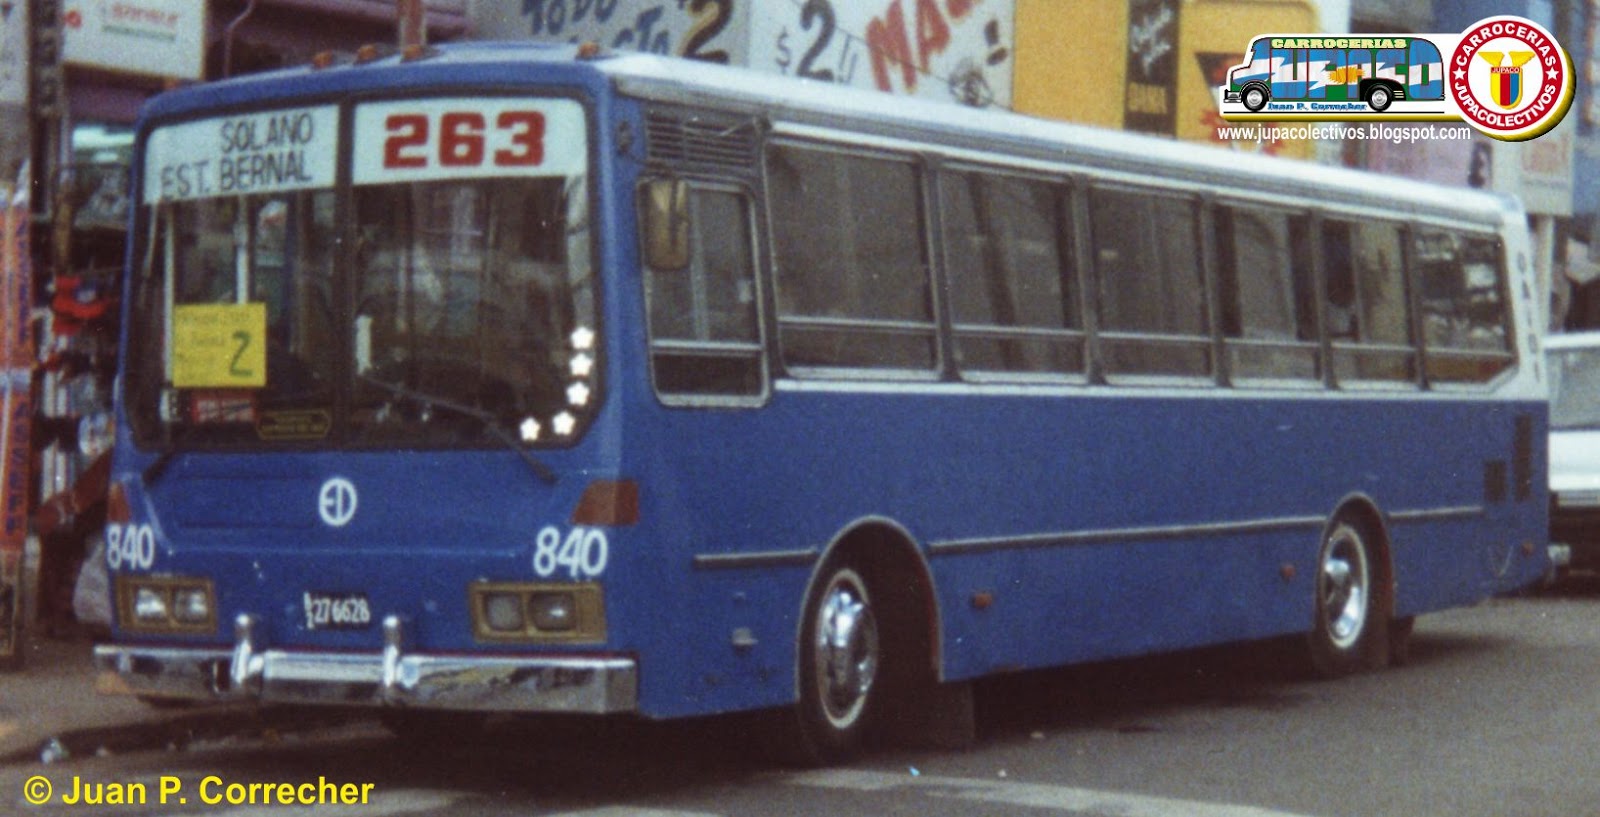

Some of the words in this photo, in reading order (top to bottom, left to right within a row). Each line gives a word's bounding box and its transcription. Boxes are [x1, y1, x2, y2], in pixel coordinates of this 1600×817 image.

[220, 112, 313, 154] SOLANO
[383, 110, 545, 170] 263
[160, 159, 210, 200] EST.
[219, 150, 313, 191] BERNAL
[230, 329, 255, 378] 2
[107, 523, 155, 570] 840
[533, 525, 608, 577] 840
